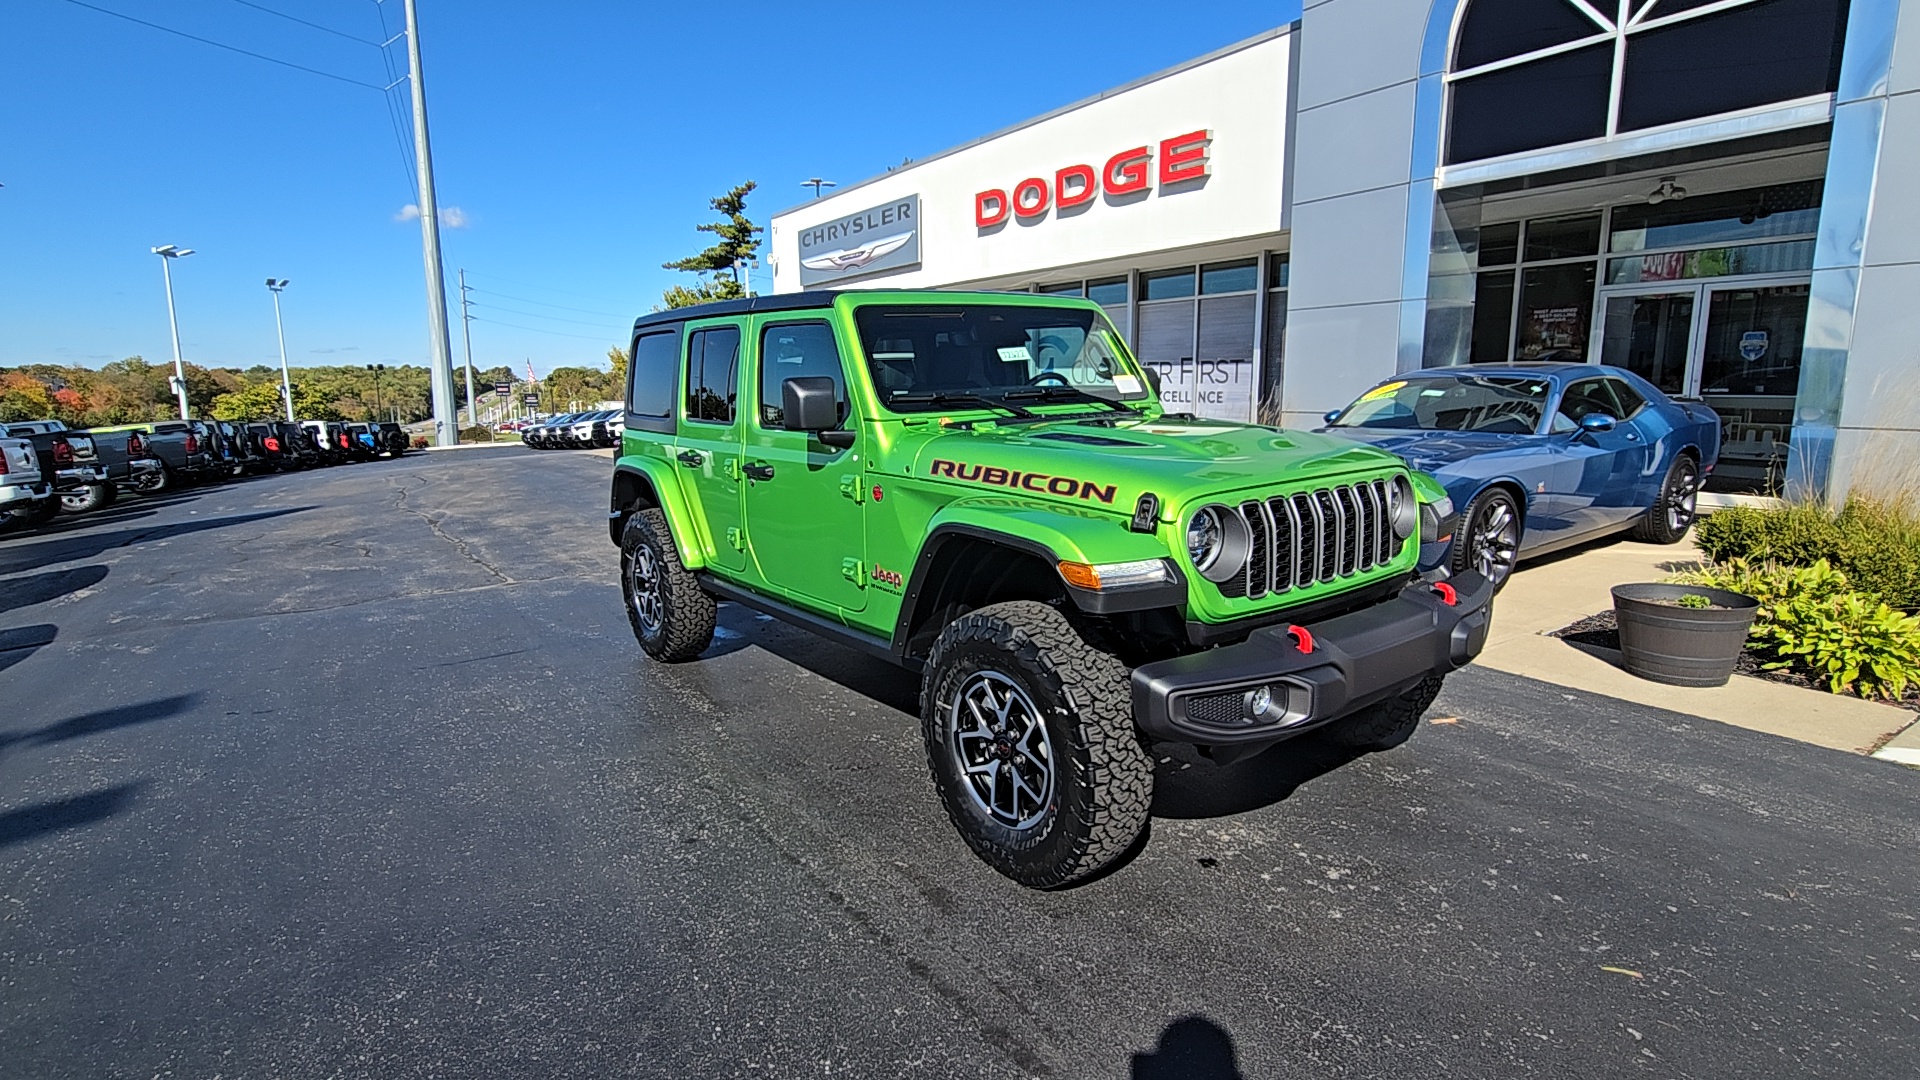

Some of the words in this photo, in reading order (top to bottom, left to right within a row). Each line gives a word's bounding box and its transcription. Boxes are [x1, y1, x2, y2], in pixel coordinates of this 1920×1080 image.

[975, 129, 1211, 228] DODGE
[801, 202, 912, 248] CHRYSLER
[1179, 357, 1245, 385] FIRST
[931, 459, 1118, 504] RUBICON
[871, 563, 903, 589] Jeep
